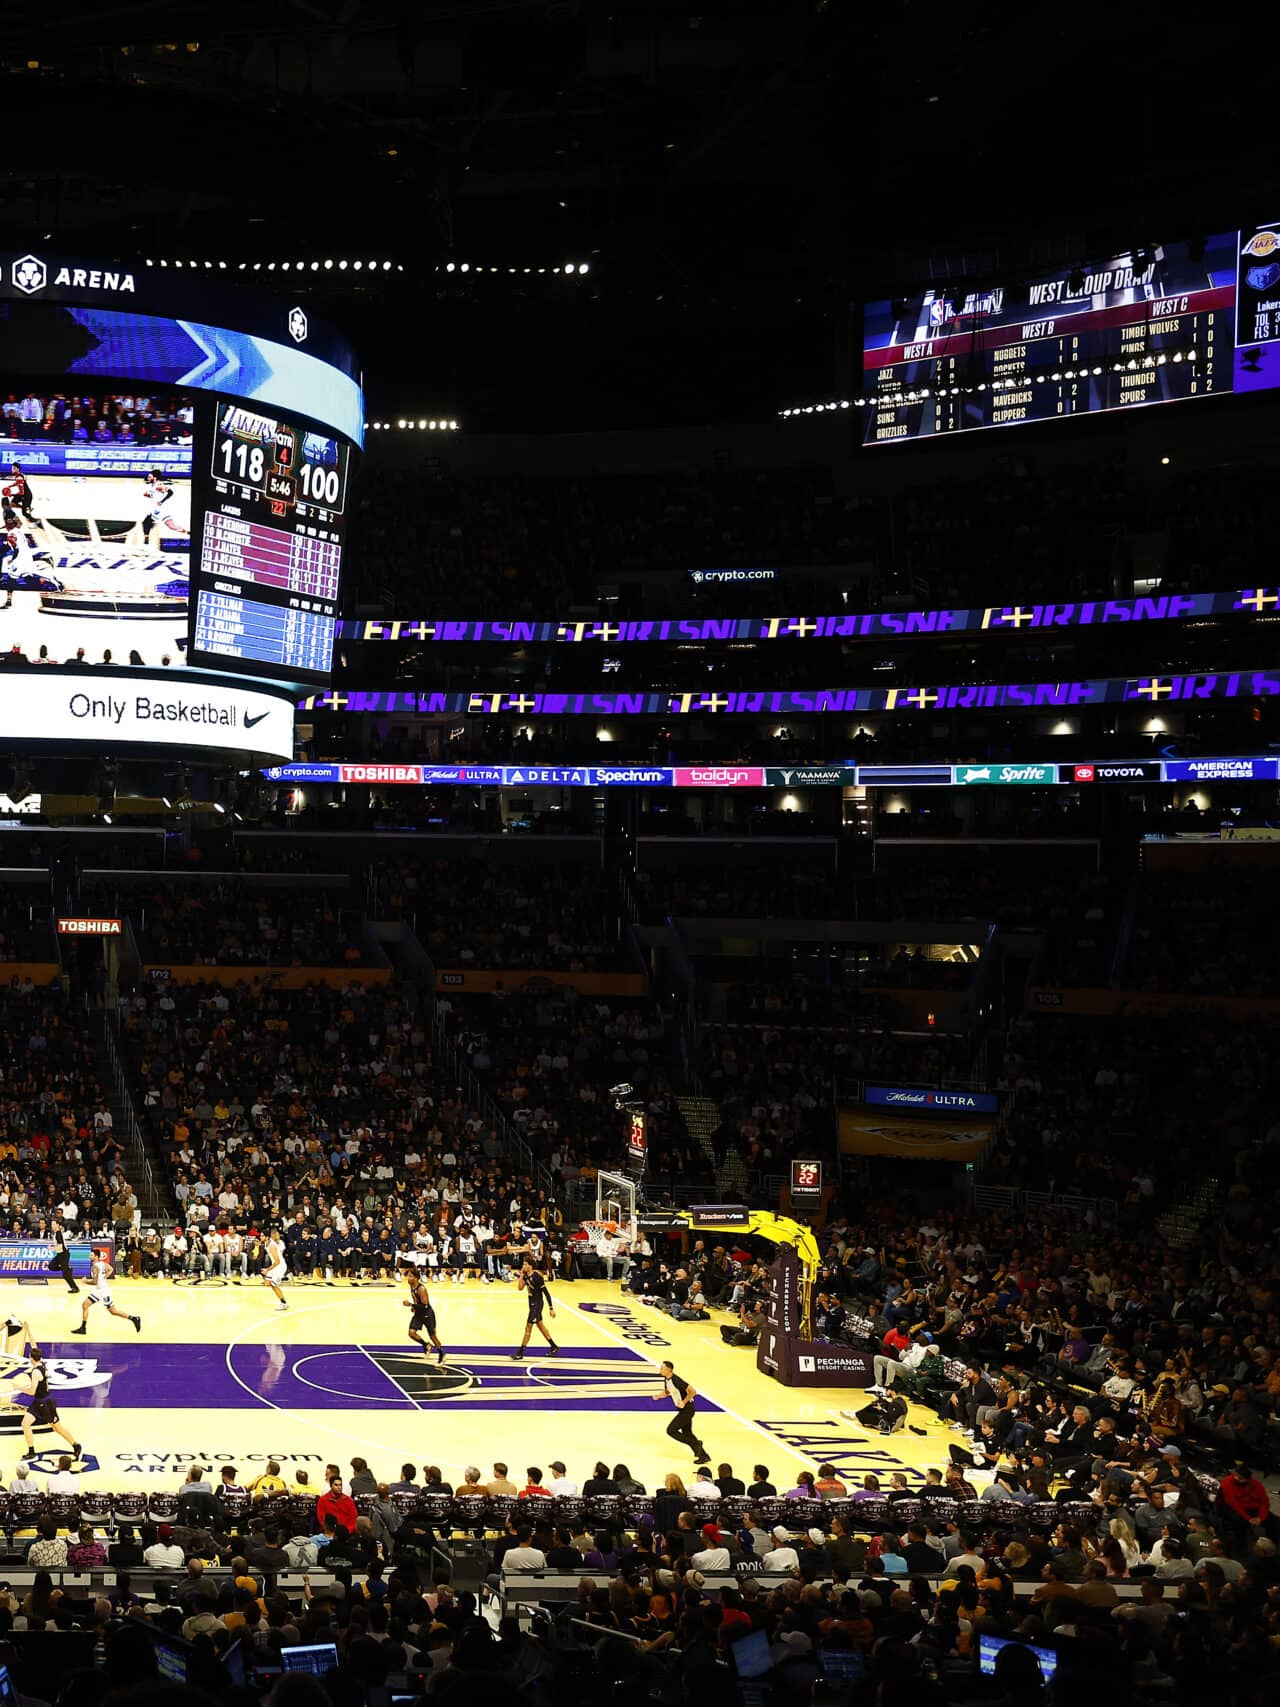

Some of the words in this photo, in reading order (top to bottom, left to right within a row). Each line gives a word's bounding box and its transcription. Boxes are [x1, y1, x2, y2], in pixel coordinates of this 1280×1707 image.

[54, 267, 136, 293] ARENA
[1029, 280, 1064, 305] WEST
[1152, 300, 1178, 316] WEST
[1180, 297, 1188, 312] C
[1255, 314, 1270, 327] TOL
[1022, 323, 1046, 340] WEST
[1047, 321, 1055, 335] B
[1121, 319, 1180, 340] TIMBEWOLVES
[1254, 326, 1270, 339] FLS
[903, 345, 924, 360] WEST
[926, 343, 933, 356] A
[993, 346, 1026, 362] NUGGETS
[877, 368, 893, 381] JAZZ
[936, 360, 942, 371] 2
[1120, 372, 1155, 388] THUNDER
[1206, 363, 1212, 375] 2
[993, 391, 1032, 407] MAVERICKS
[1071, 384, 1078, 395] 2
[1119, 390, 1146, 404] SPURS
[1206, 379, 1212, 391] 2
[876, 412, 895, 425] SUNS
[992, 408, 1026, 423] CLIPPERS
[876, 425, 908, 440] GRIZZLIES
[948, 418, 954, 429] 2
[276, 432, 293, 449] QTR
[279, 450, 288, 463] 4
[220, 439, 265, 482] 118
[299, 463, 340, 504] 100
[270, 478, 291, 496] 5:46
[273, 501, 284, 514] 22
[705, 568, 775, 582] crypto.com
[69, 693, 126, 724] Only
[136, 696, 236, 727] Basketball
[282, 767, 332, 778] crypto.com
[1097, 767, 1144, 777] TOYOTA
[1188, 761, 1253, 771] AMERICAN
[344, 767, 418, 781] TOSHIBA
[466, 771, 500, 780] ULTRA
[528, 770, 581, 782] DELTA
[595, 769, 661, 783] Spectrum
[691, 769, 748, 784] boldyn
[1000, 767, 1045, 781] Sprite
[1197, 769, 1253, 779] EXPRESS
[59, 920, 120, 933] TOSHIBA
[935, 1095, 976, 1106] ULTRA
[631, 1127, 643, 1147] 22
[799, 1173, 814, 1184] 22
[22, 1247, 54, 1259] LEADS
[2, 1260, 40, 1271] HEALTH
[608, 1316, 672, 1347] bibigo
[817, 1358, 865, 1366] PECHANGA
[115, 1452, 324, 1463] crypto.com
[123, 1464, 217, 1473] AREN
